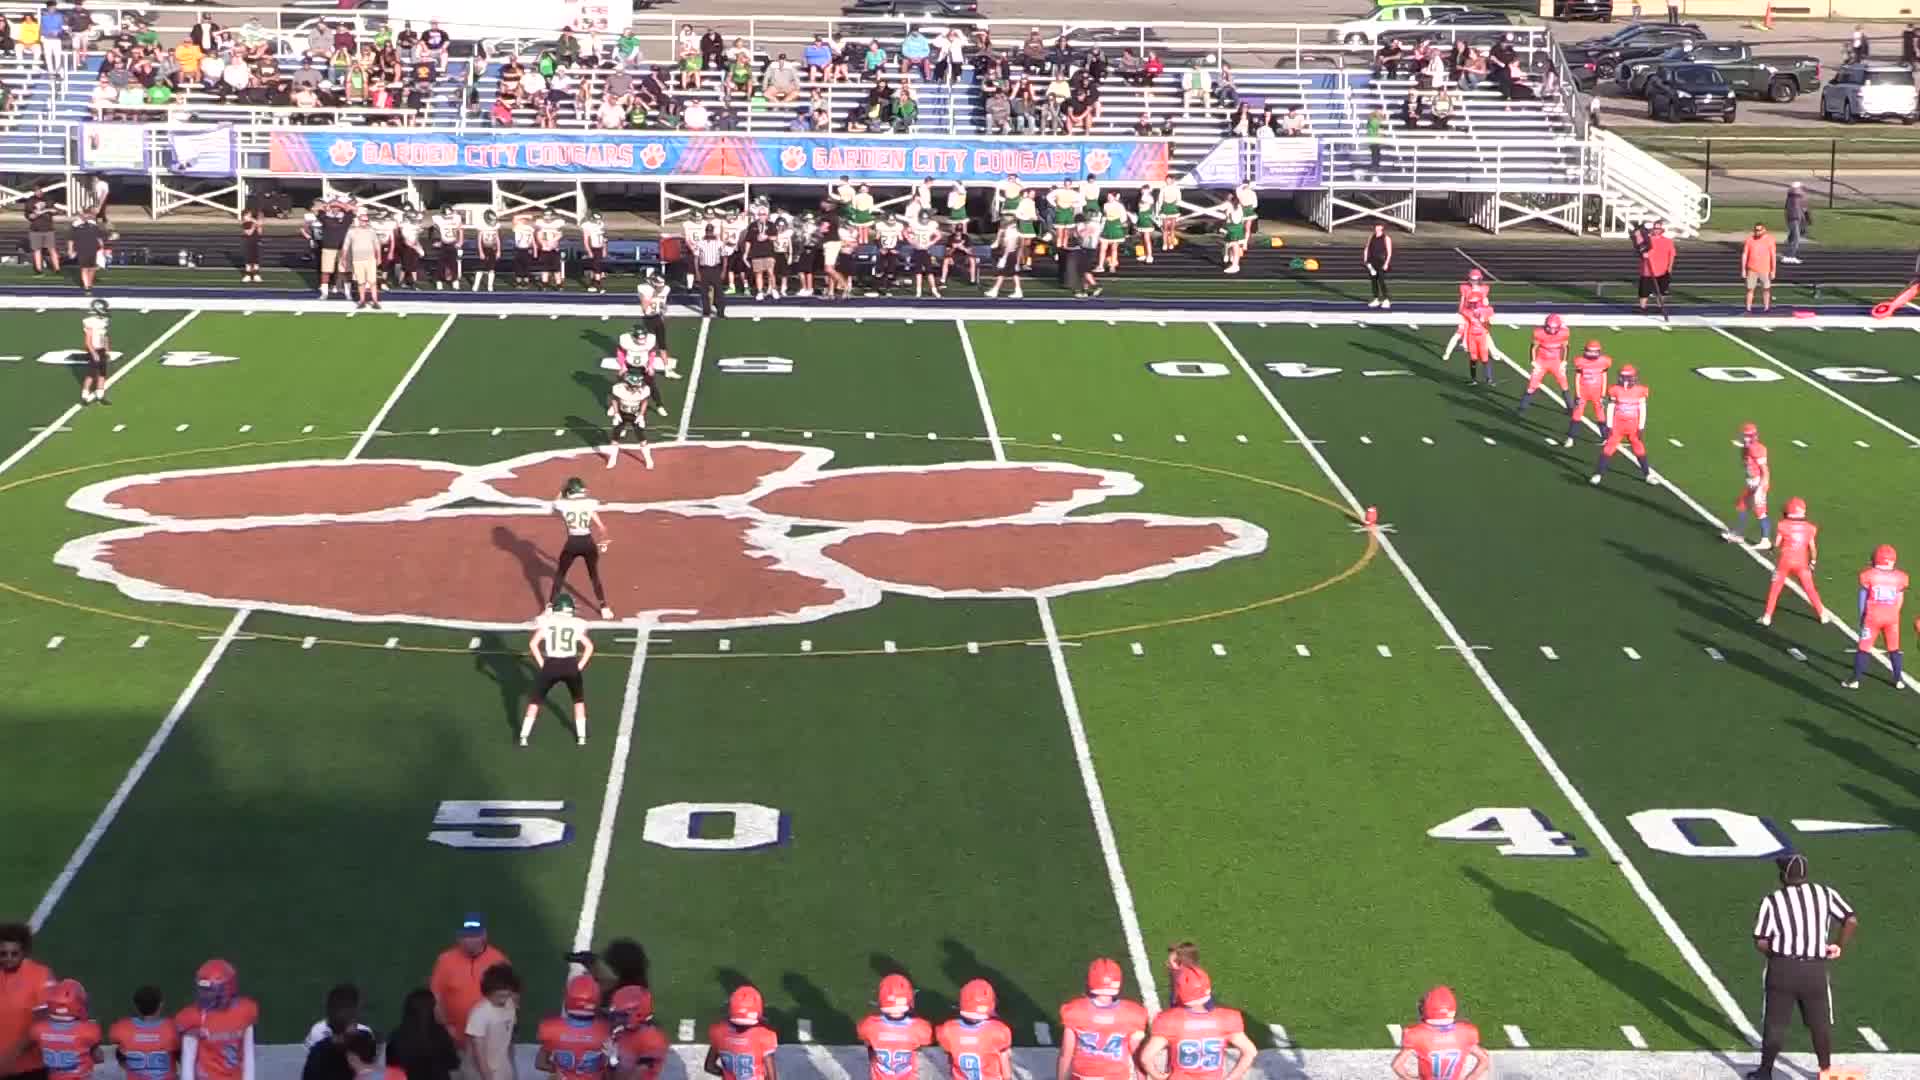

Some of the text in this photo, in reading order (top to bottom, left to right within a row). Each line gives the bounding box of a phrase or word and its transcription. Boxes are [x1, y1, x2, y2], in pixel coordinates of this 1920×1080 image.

[362, 143, 634, 168] GARDEN CITY COUGARS
[812, 147, 1084, 174] GARDEN CITY COUGARS
[547, 626, 575, 652] 19
[1428, 1049, 1461, 1080] 17
